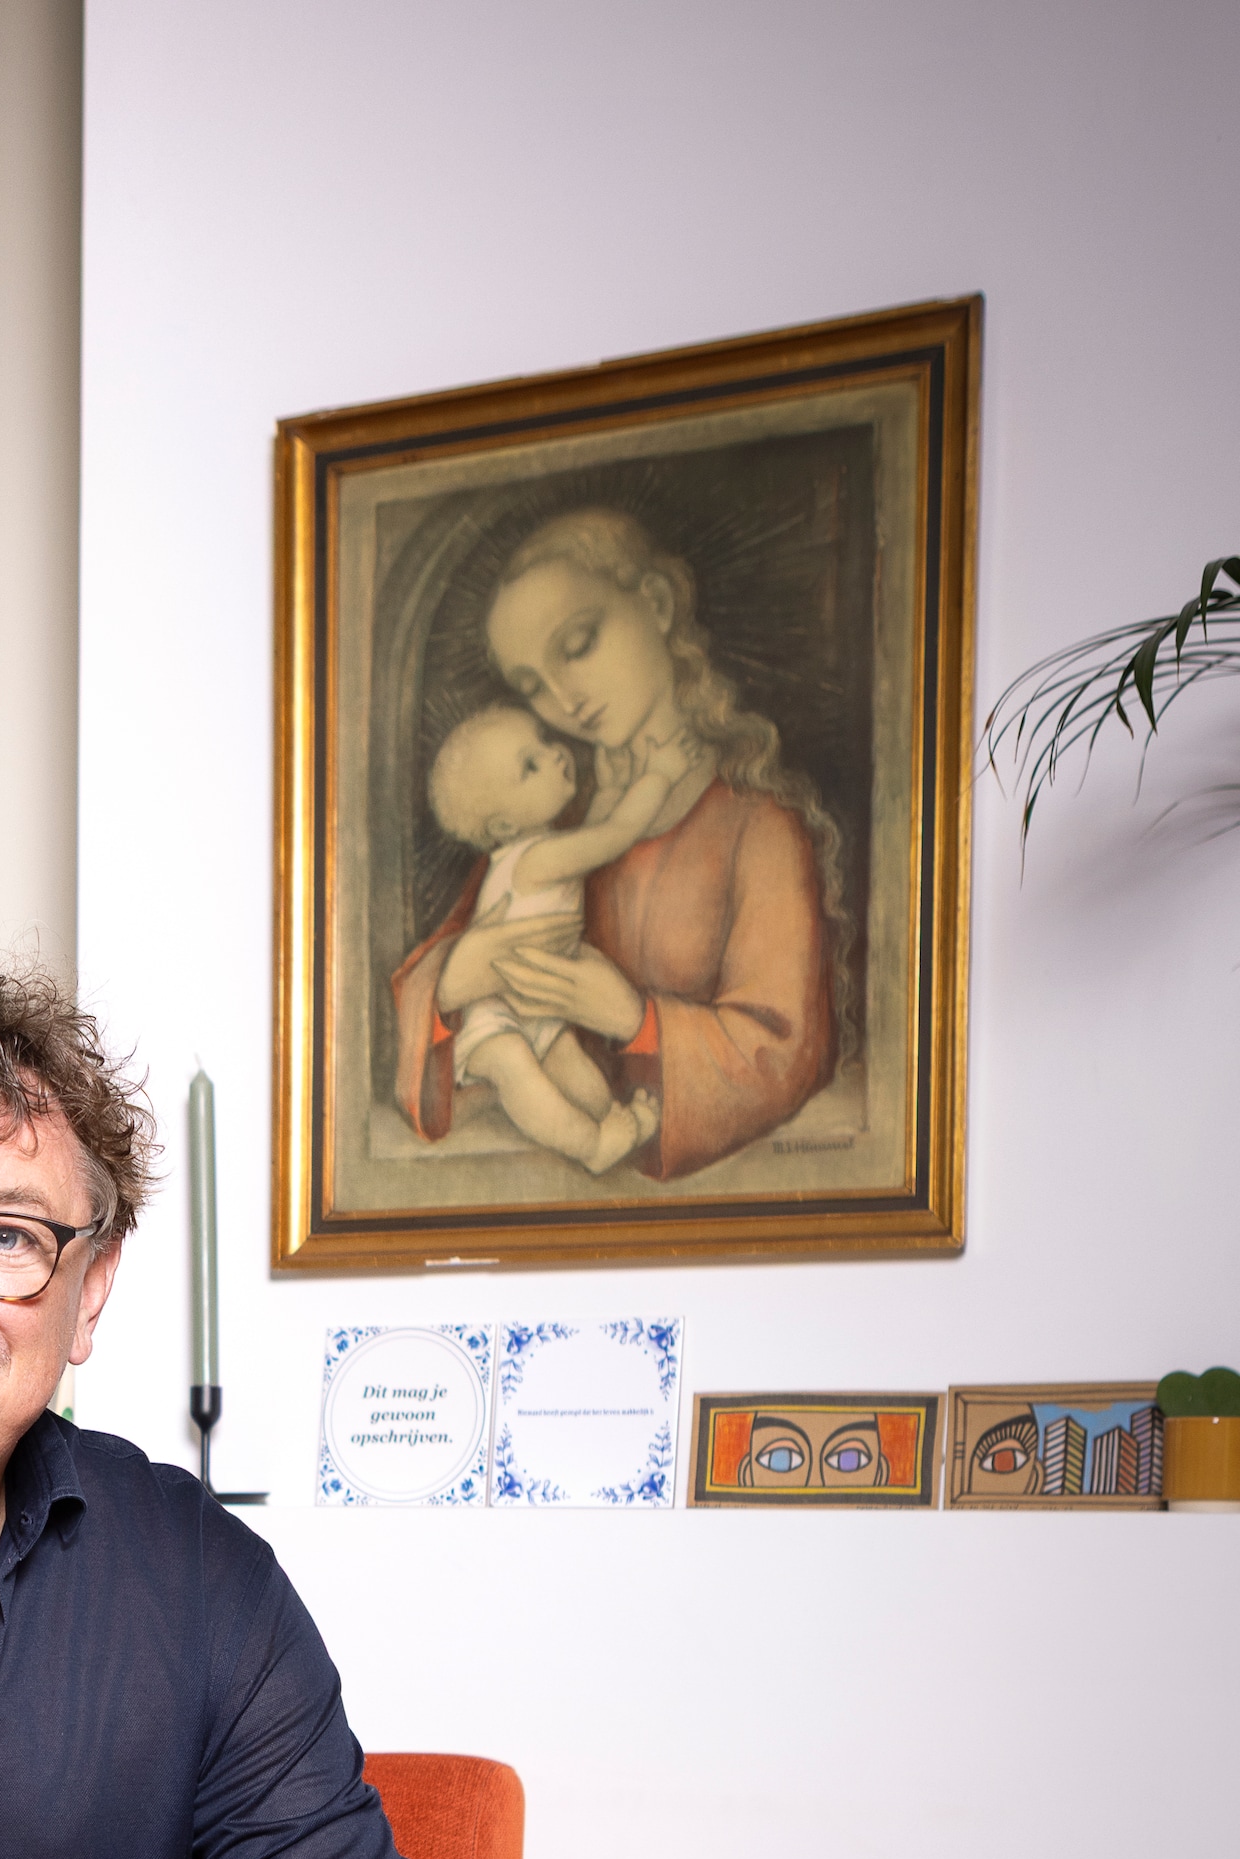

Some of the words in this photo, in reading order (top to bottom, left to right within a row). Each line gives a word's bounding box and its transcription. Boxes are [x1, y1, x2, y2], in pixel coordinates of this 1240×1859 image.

[362, 1385, 388, 1400] Dit
[392, 1388, 428, 1402] mag
[431, 1385, 448, 1401] je
[370, 1408, 436, 1424] gewoon
[350, 1430, 454, 1446] opschrijven.
